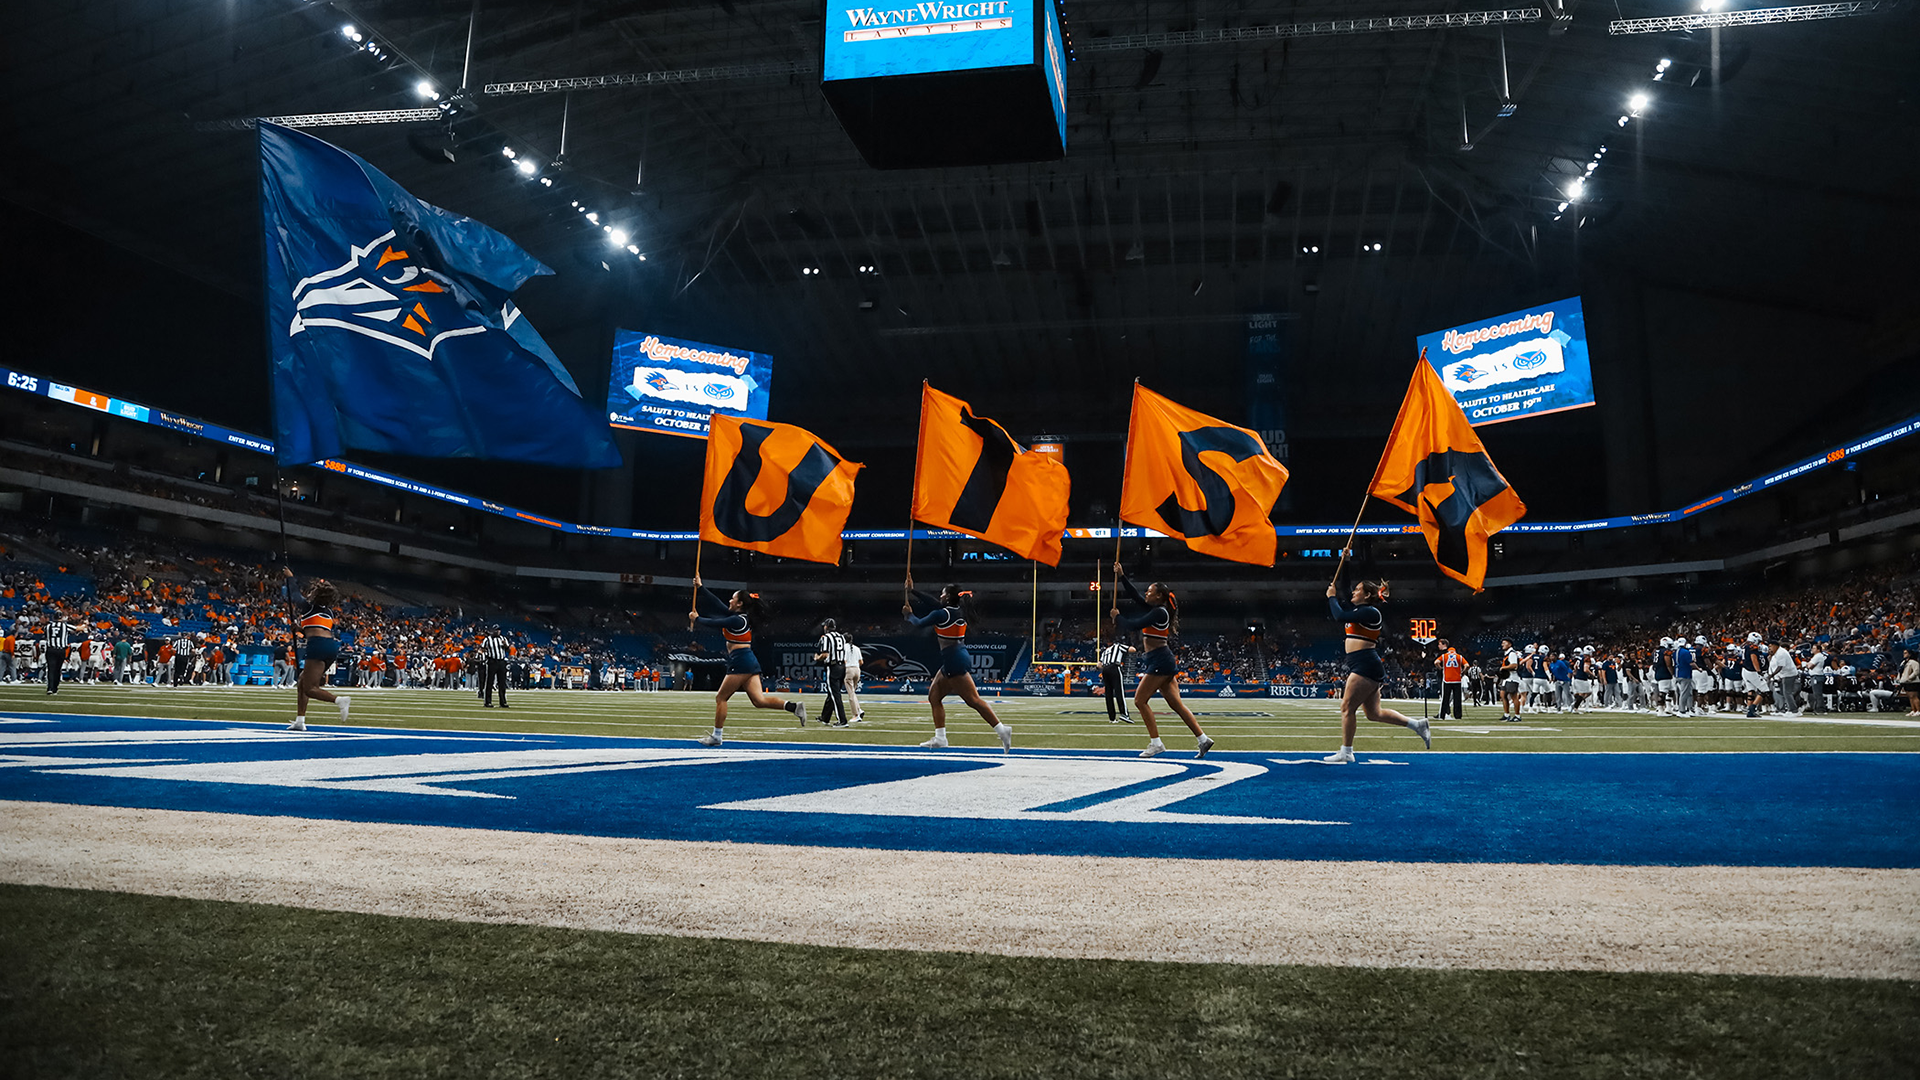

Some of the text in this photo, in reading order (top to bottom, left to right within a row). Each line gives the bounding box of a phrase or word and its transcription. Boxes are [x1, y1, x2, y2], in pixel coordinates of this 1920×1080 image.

[850, 19, 1007, 40] LAWYERS
[1249, 320, 1277, 329] LIGHT
[1442, 311, 1555, 354] Homecoming
[640, 335, 749, 375] Homecoming
[7, 371, 38, 392] 6:25
[1458, 383, 1556, 409] SALUTE TO HEALTHCARE
[641, 405, 711, 421] SALUTE TO HEALT
[1472, 401, 1520, 418] OCTOBER
[654, 417, 701, 431] OCTOBER
[228, 435, 245, 445] ENTER
[246, 439, 260, 449] NOW
[260, 443, 271, 452] FOR
[1262, 430, 1286, 444] UD
[1826, 448, 1845, 463] $888
[1893, 426, 1908, 438] SCORE
[1908, 424, 1912, 432] A
[324, 459, 346, 473] $888
[353, 469, 364, 477] YOUR
[395, 480, 408, 488] SCORE
[714, 422, 841, 542] U
[1155, 426, 1267, 539] S
[1075, 529, 1083, 537] 3
[1401, 525, 1422, 534] $88
[53, 628, 59, 637] F
[21, 644, 32, 652] 25
[92, 645, 99, 653] 7
[836, 637, 843, 650] B
[782, 652, 818, 666] BUD
[971, 654, 994, 668] UD
[971, 668, 1001, 680] GHT
[1825, 676, 1834, 685] 28
[1270, 685, 1309, 697] RBFCU
